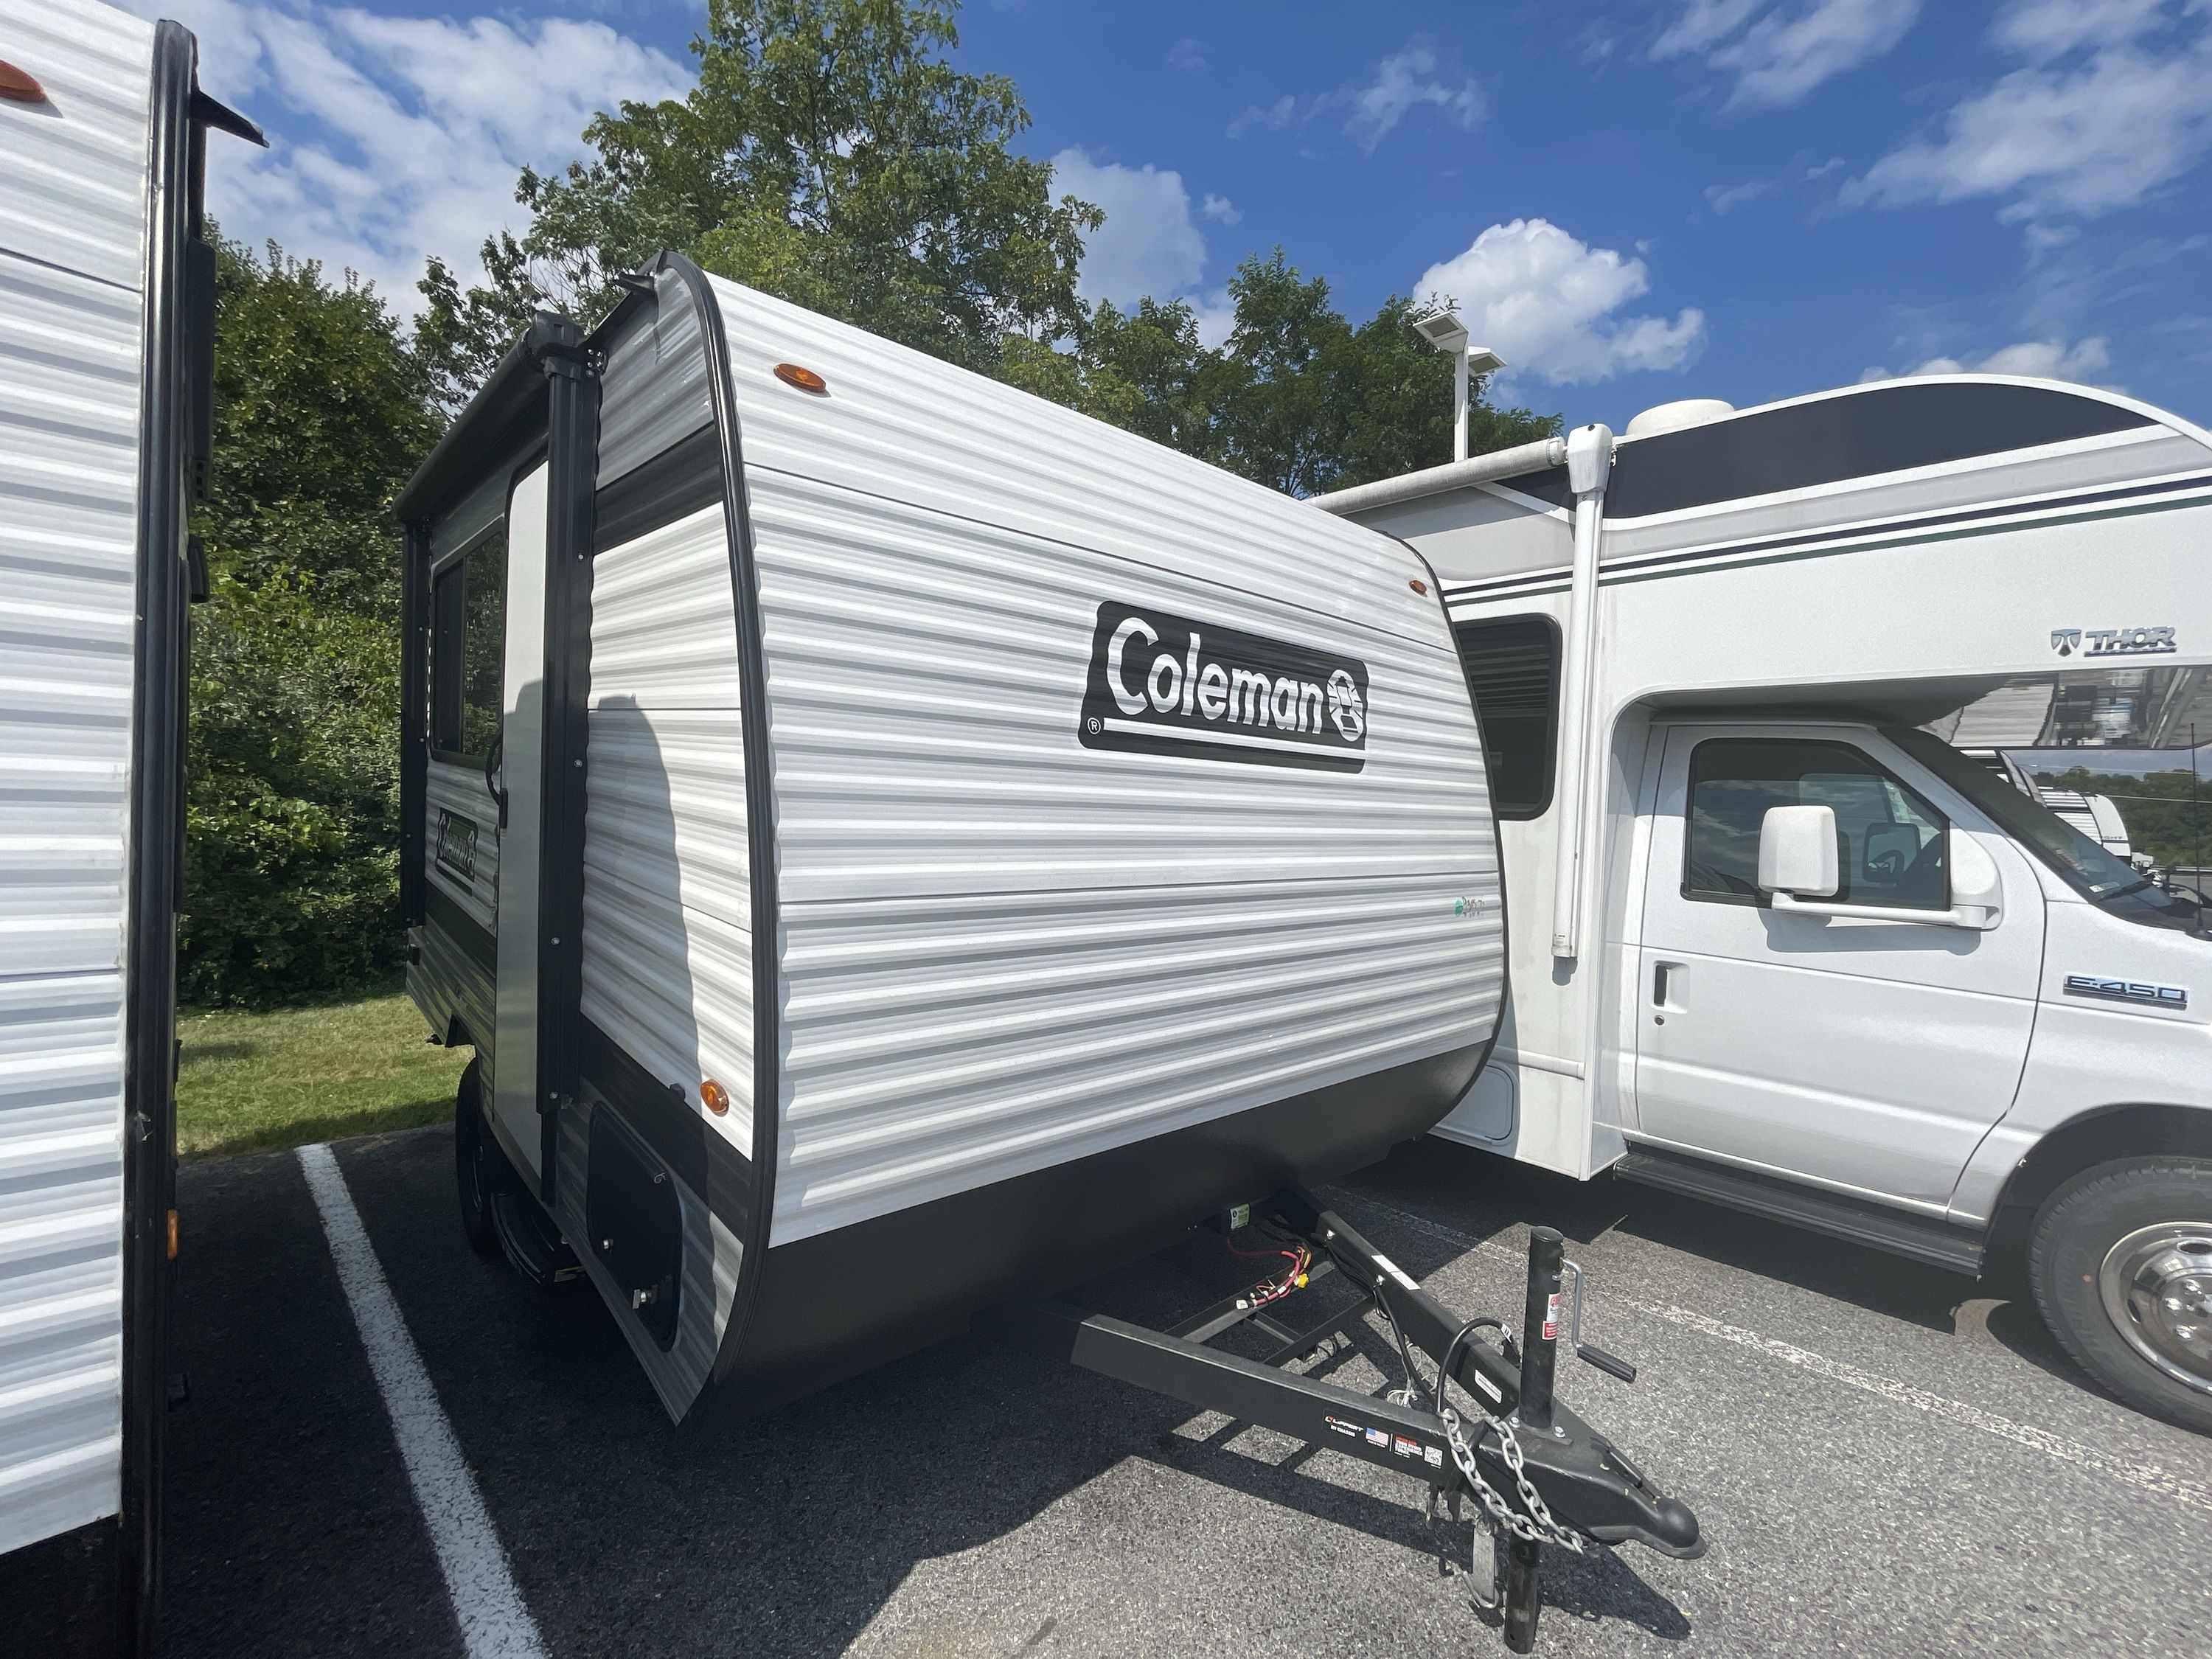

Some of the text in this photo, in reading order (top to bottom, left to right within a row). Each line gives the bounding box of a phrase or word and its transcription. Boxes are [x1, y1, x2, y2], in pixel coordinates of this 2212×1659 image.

[2085, 626, 2177, 651] THOR
[1107, 617, 1324, 734] Coleman
[2067, 975, 2187, 1001] E-450
